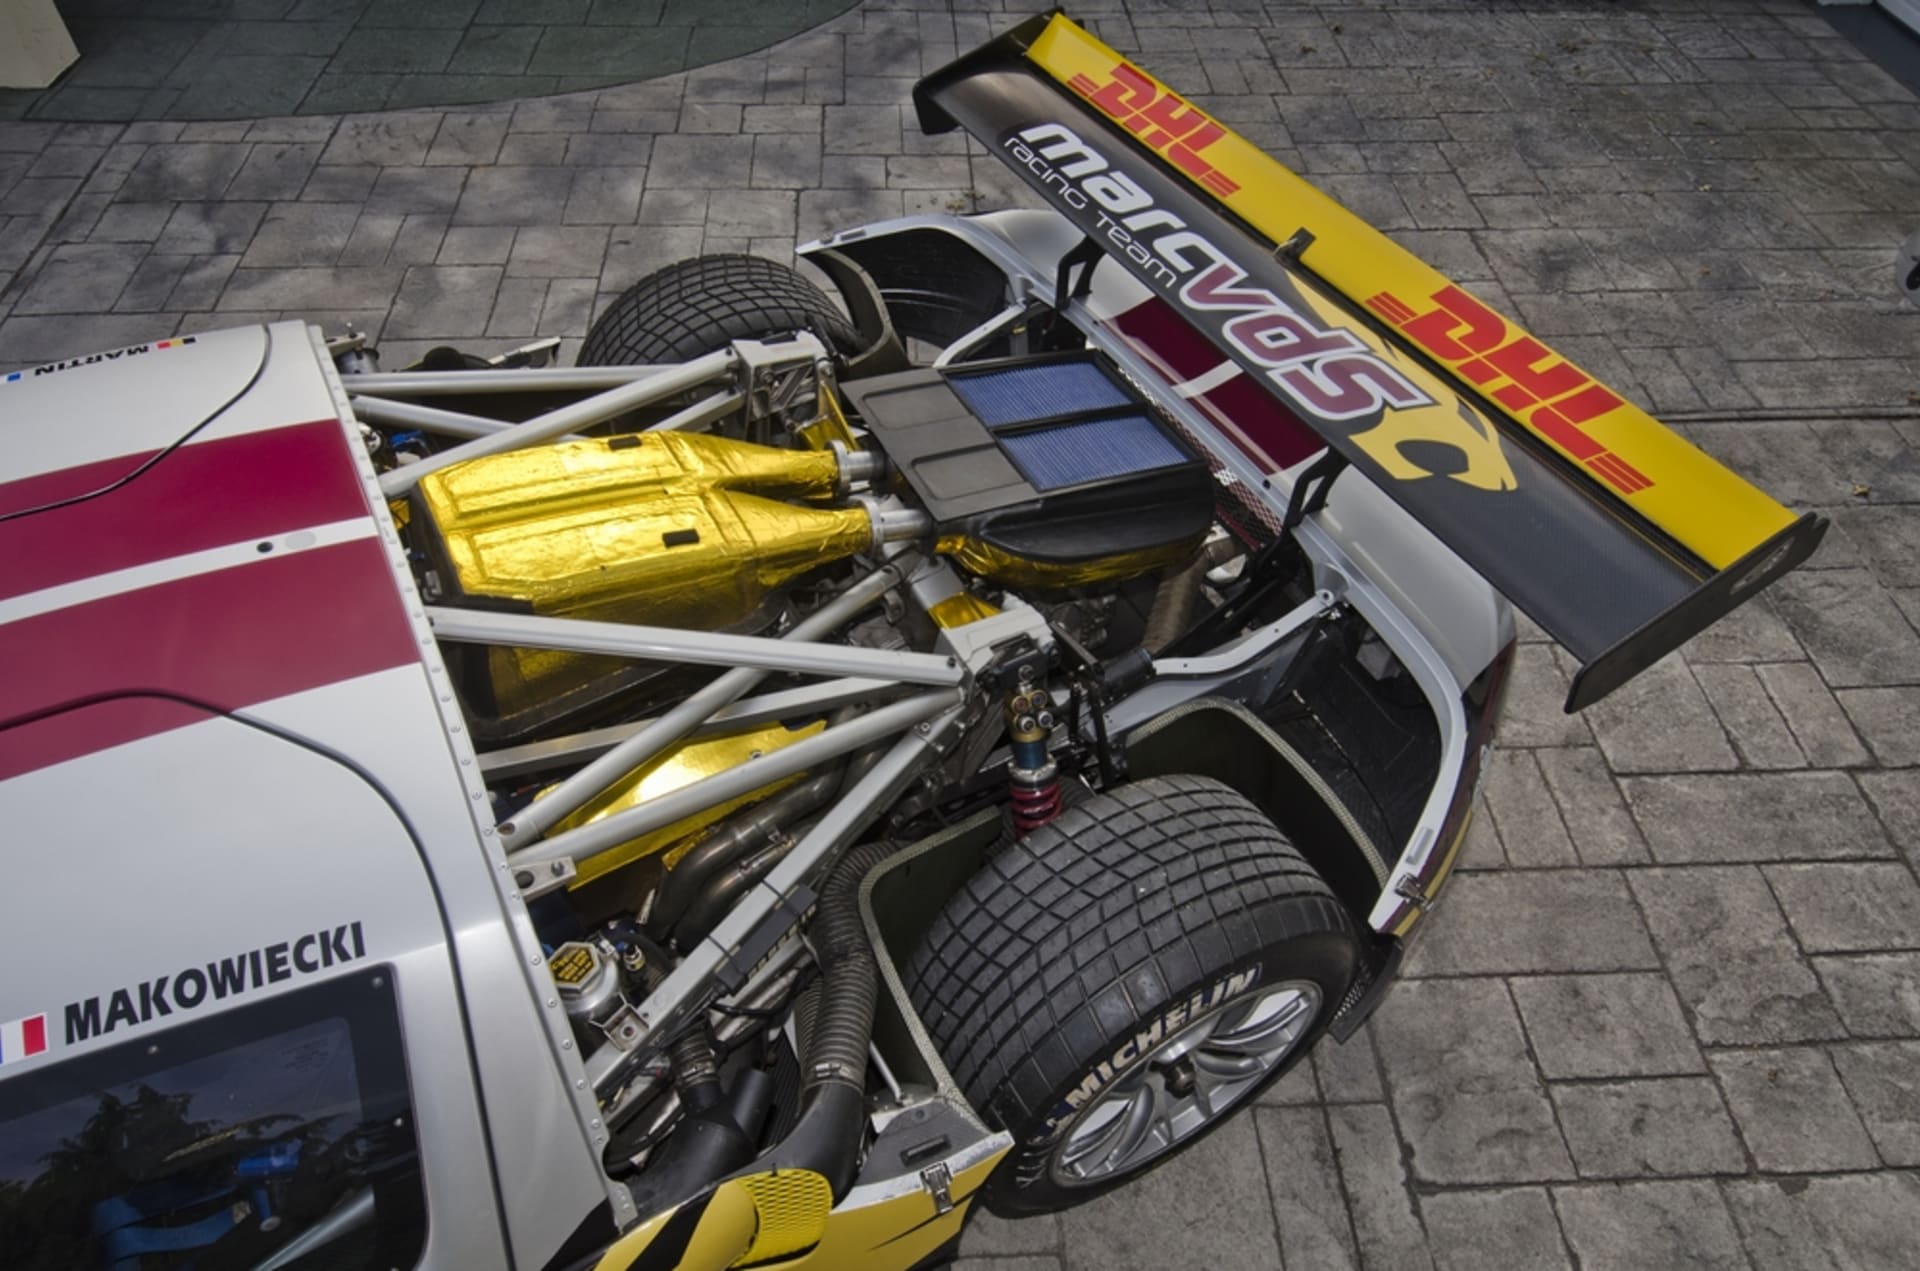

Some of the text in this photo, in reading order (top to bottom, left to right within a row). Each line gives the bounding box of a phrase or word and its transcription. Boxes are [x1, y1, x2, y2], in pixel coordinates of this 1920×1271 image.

[1089, 62, 1228, 178] DHL
[34, 345, 149, 377] MARTIN
[1400, 285, 1625, 461] DHL
[64, 921, 367, 1046] MAKOWIECKI
[1064, 967, 1259, 1110] MICHELIN
